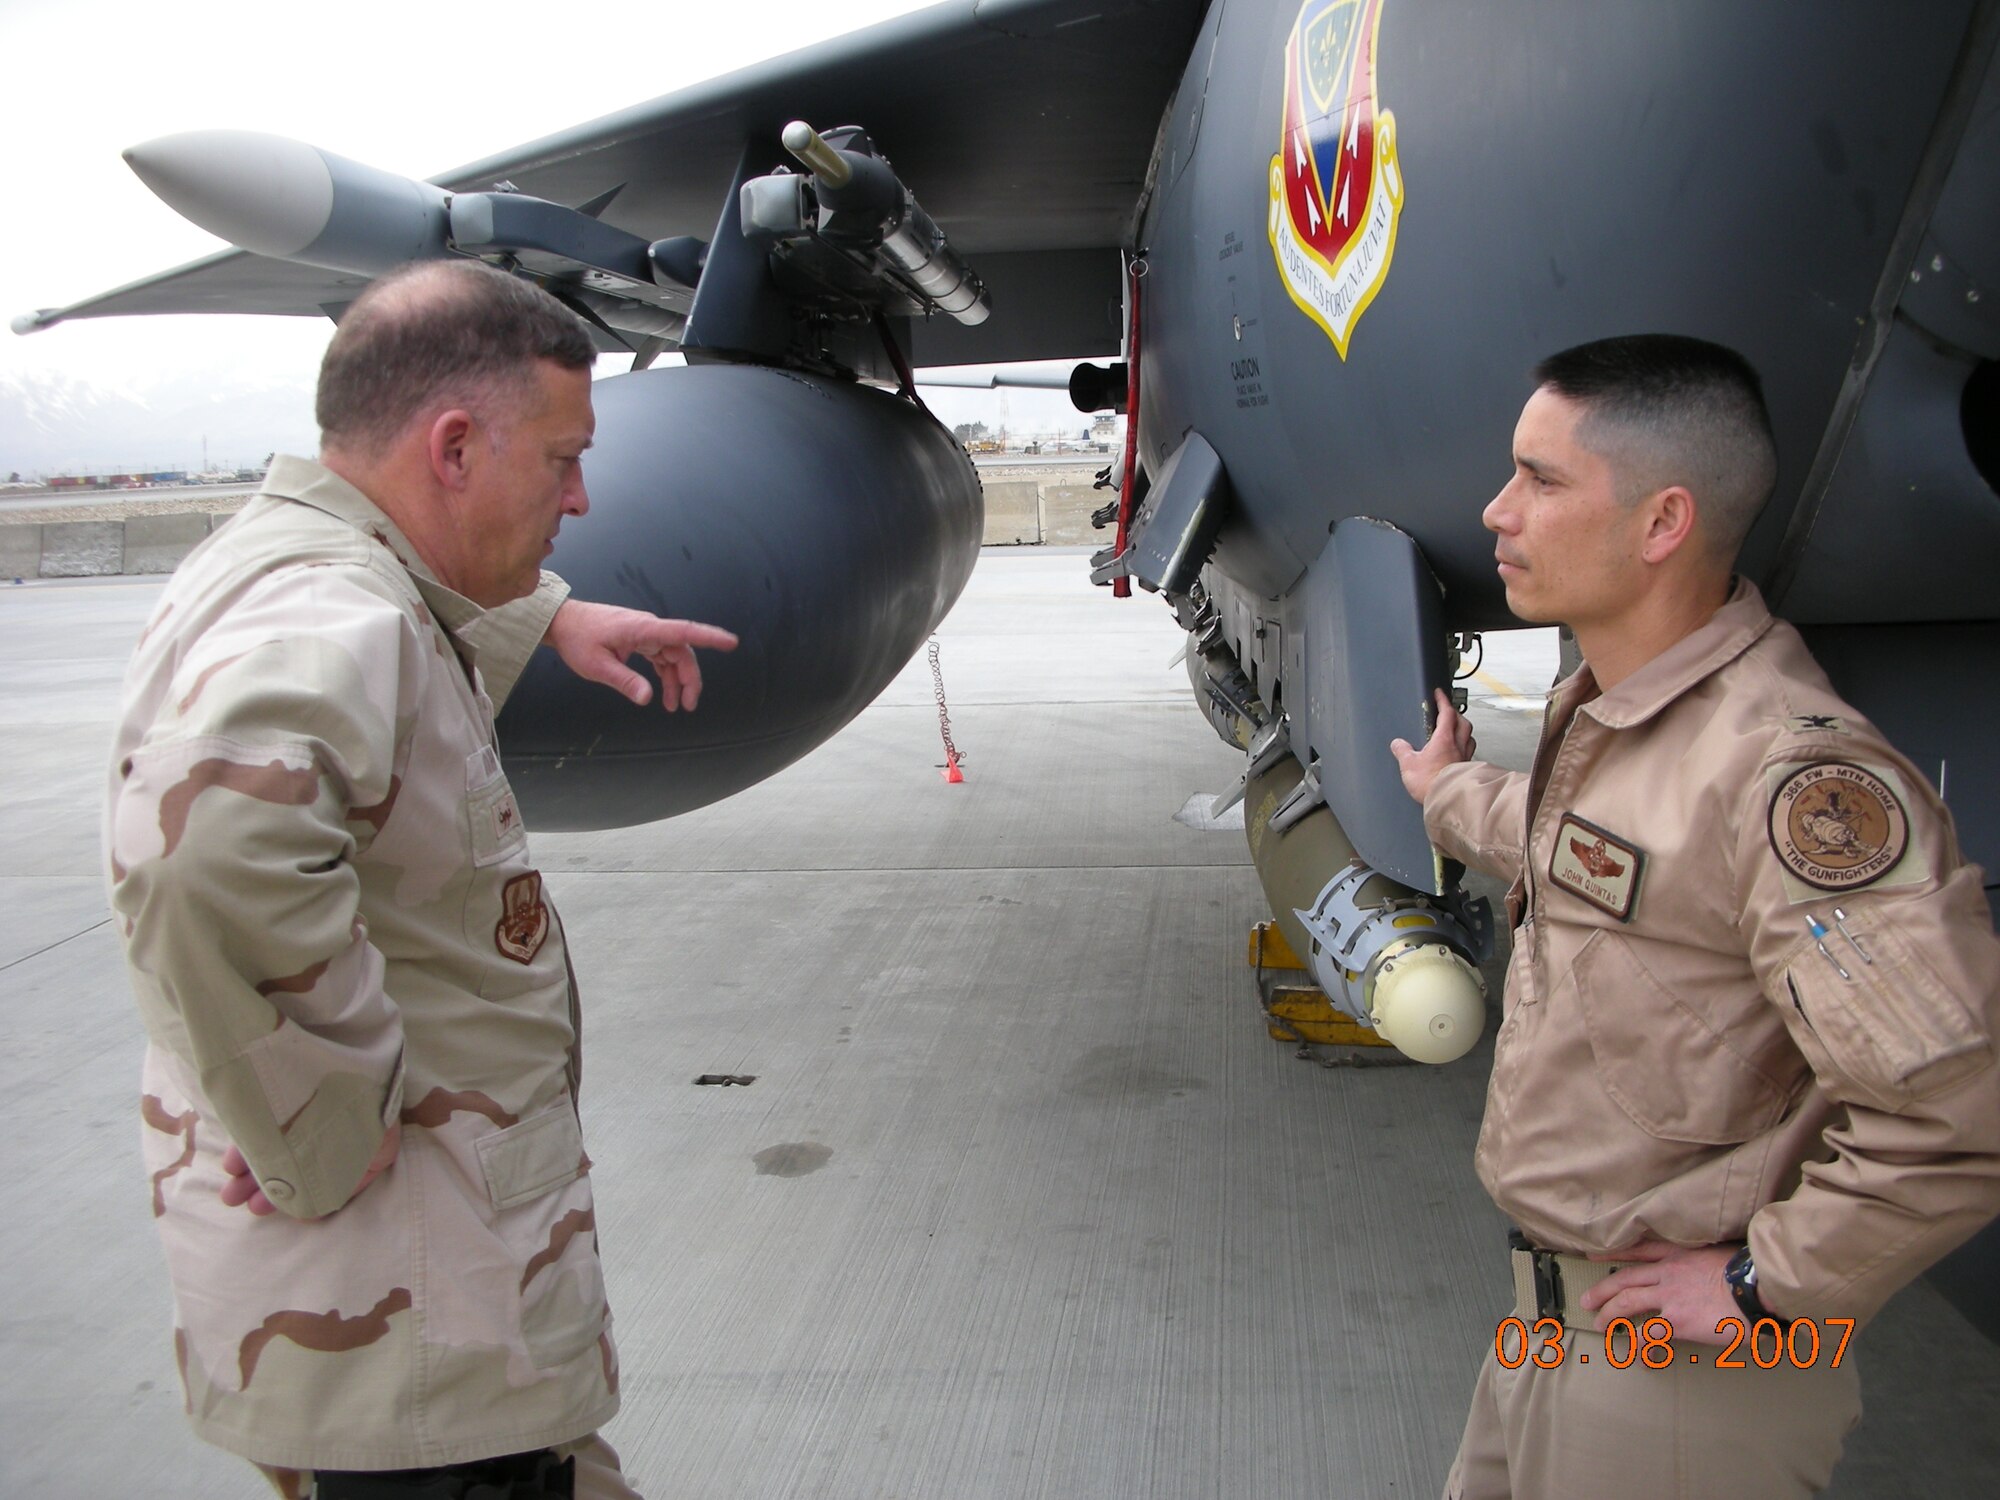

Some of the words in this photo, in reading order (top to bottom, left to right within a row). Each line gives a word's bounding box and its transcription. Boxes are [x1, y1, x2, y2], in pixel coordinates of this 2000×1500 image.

[1279, 227, 1324, 307] AUDENTES
[1326, 259, 1364, 317] FORTUNA
[1363, 195, 1386, 270] JUVAT
[1230, 356, 1260, 381] CAUTION
[1783, 780, 1803, 801] 366
[1805, 769, 1823, 782] FW
[1837, 768, 1864, 783] MTN
[1866, 779, 1896, 812] HOME
[1562, 867, 1584, 886] JOHN
[1585, 880, 1617, 905] QUINTAS
